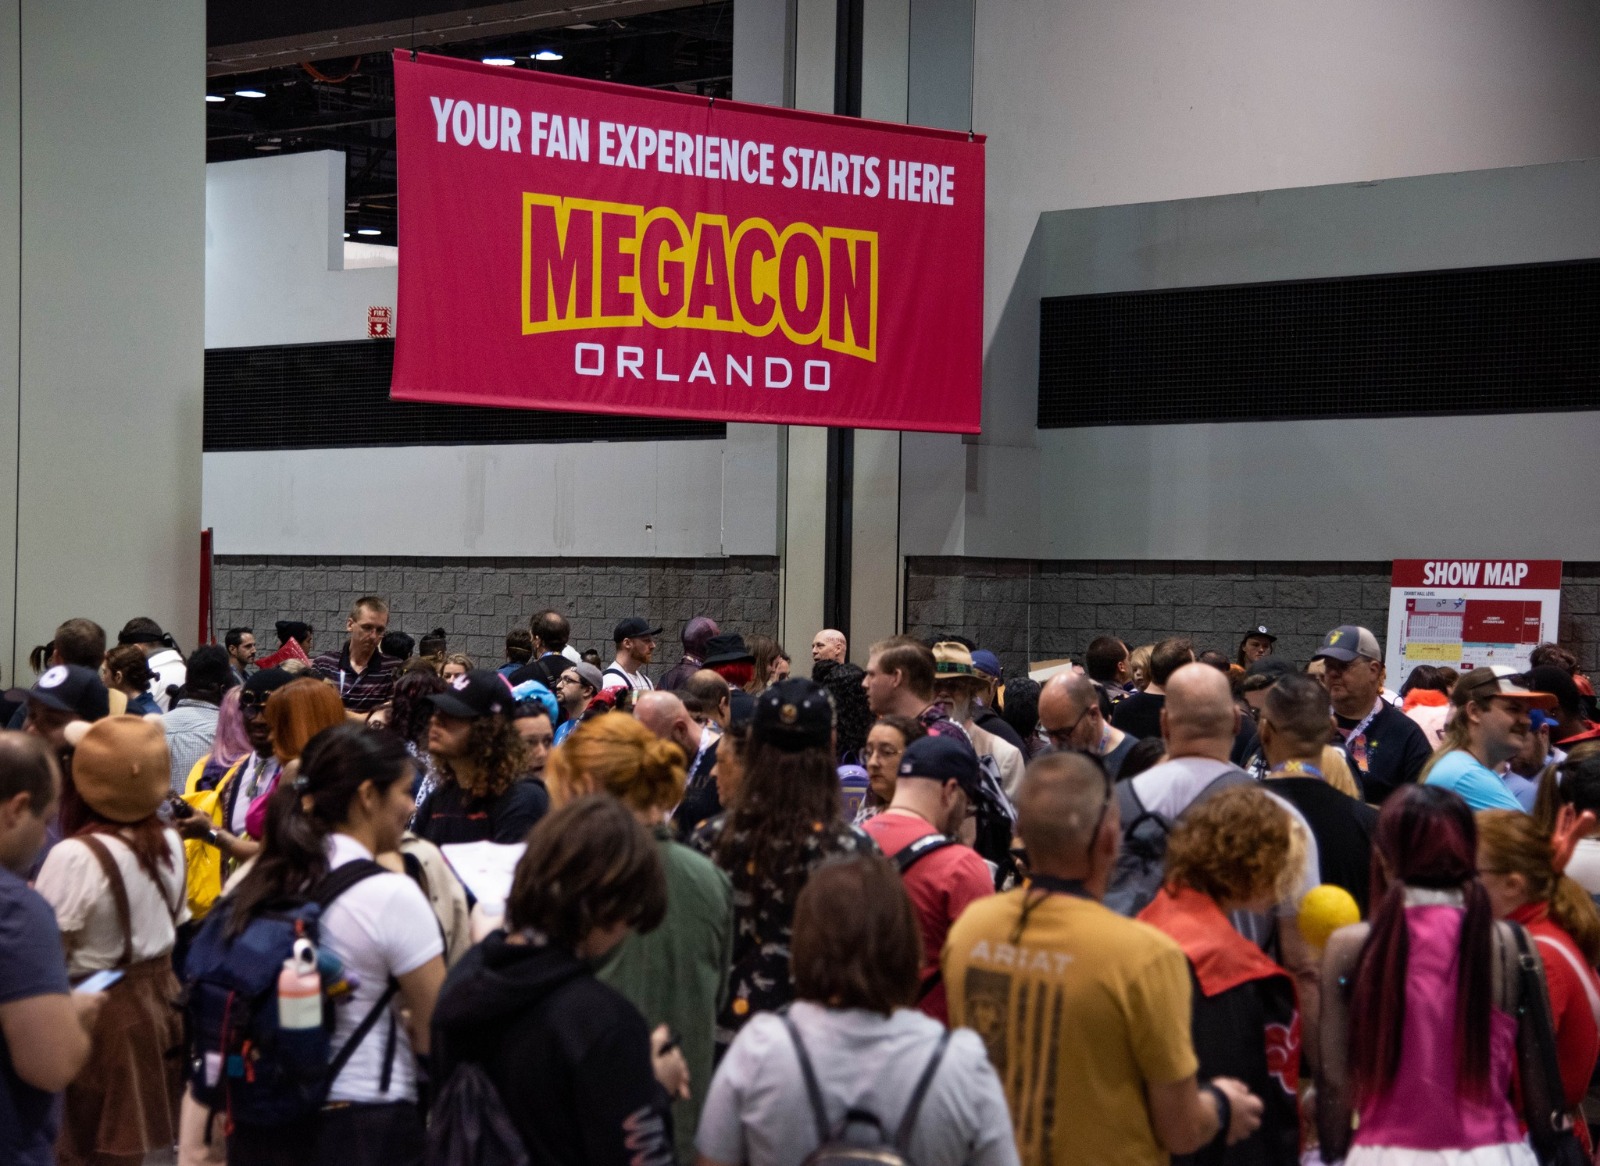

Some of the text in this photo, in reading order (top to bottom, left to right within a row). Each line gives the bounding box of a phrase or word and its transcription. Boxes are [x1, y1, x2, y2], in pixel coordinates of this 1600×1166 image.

[430, 97, 955, 206] YOUR FAN EXPERIENCE STARTS HERE
[522, 192, 878, 362] MEGACON
[575, 343, 831, 392] ORLANDO
[1423, 562, 1528, 586] SHOW MAP
[970, 940, 1073, 974] ARIAT
